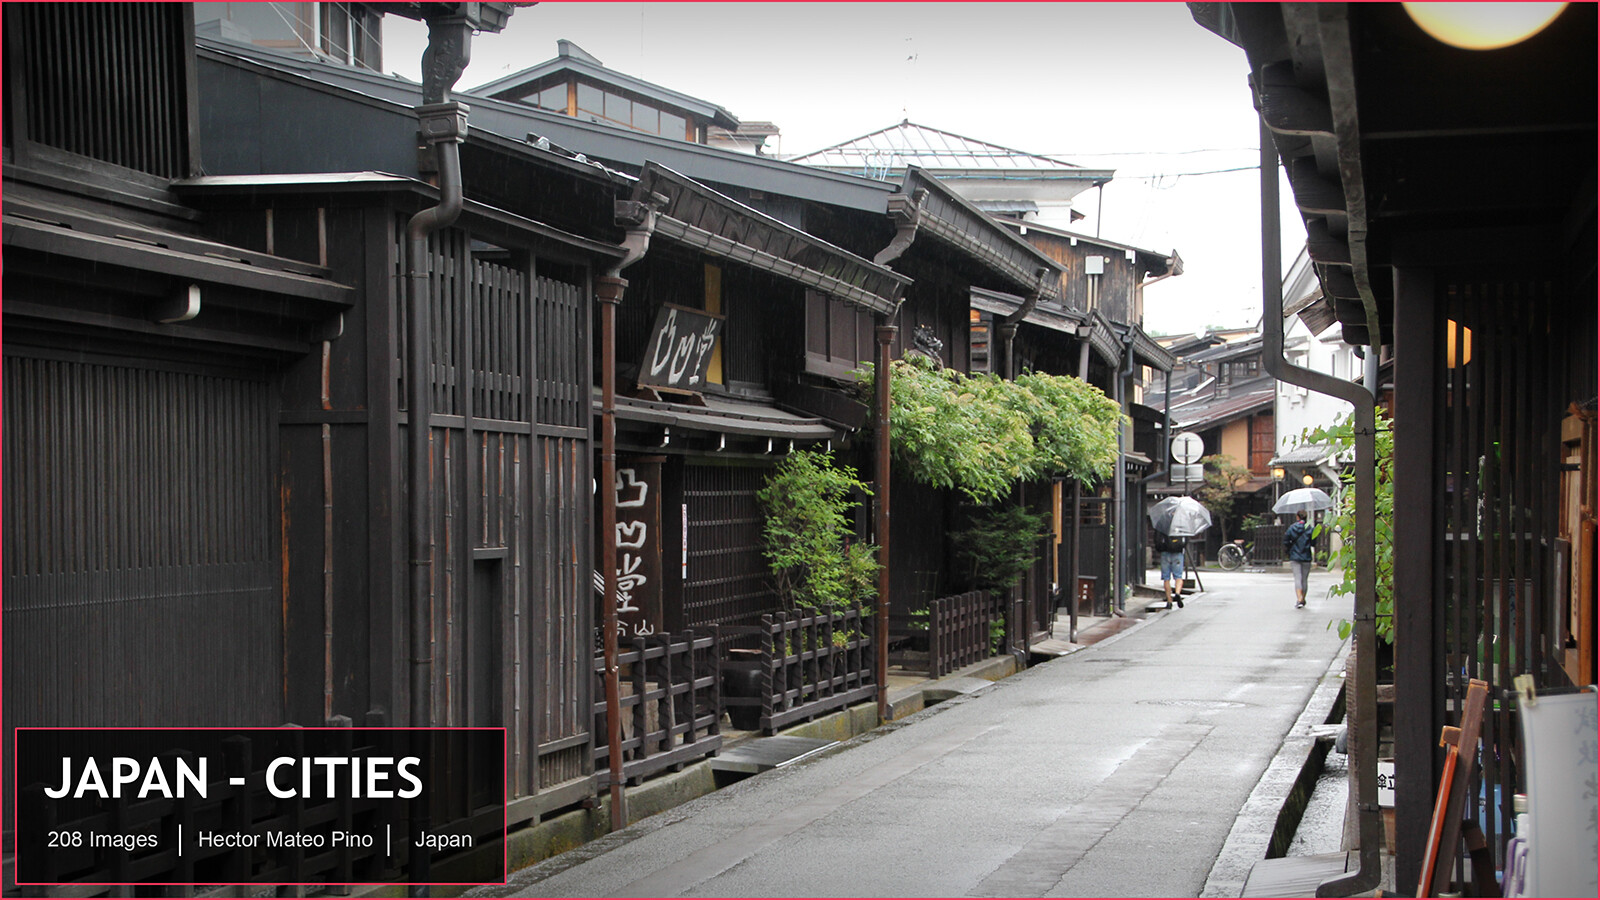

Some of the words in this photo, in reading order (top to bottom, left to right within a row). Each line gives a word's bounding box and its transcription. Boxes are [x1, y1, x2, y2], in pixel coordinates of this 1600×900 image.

[650, 308, 717, 386] 凸凹堂
[615, 468, 648, 613] 凸凹堂
